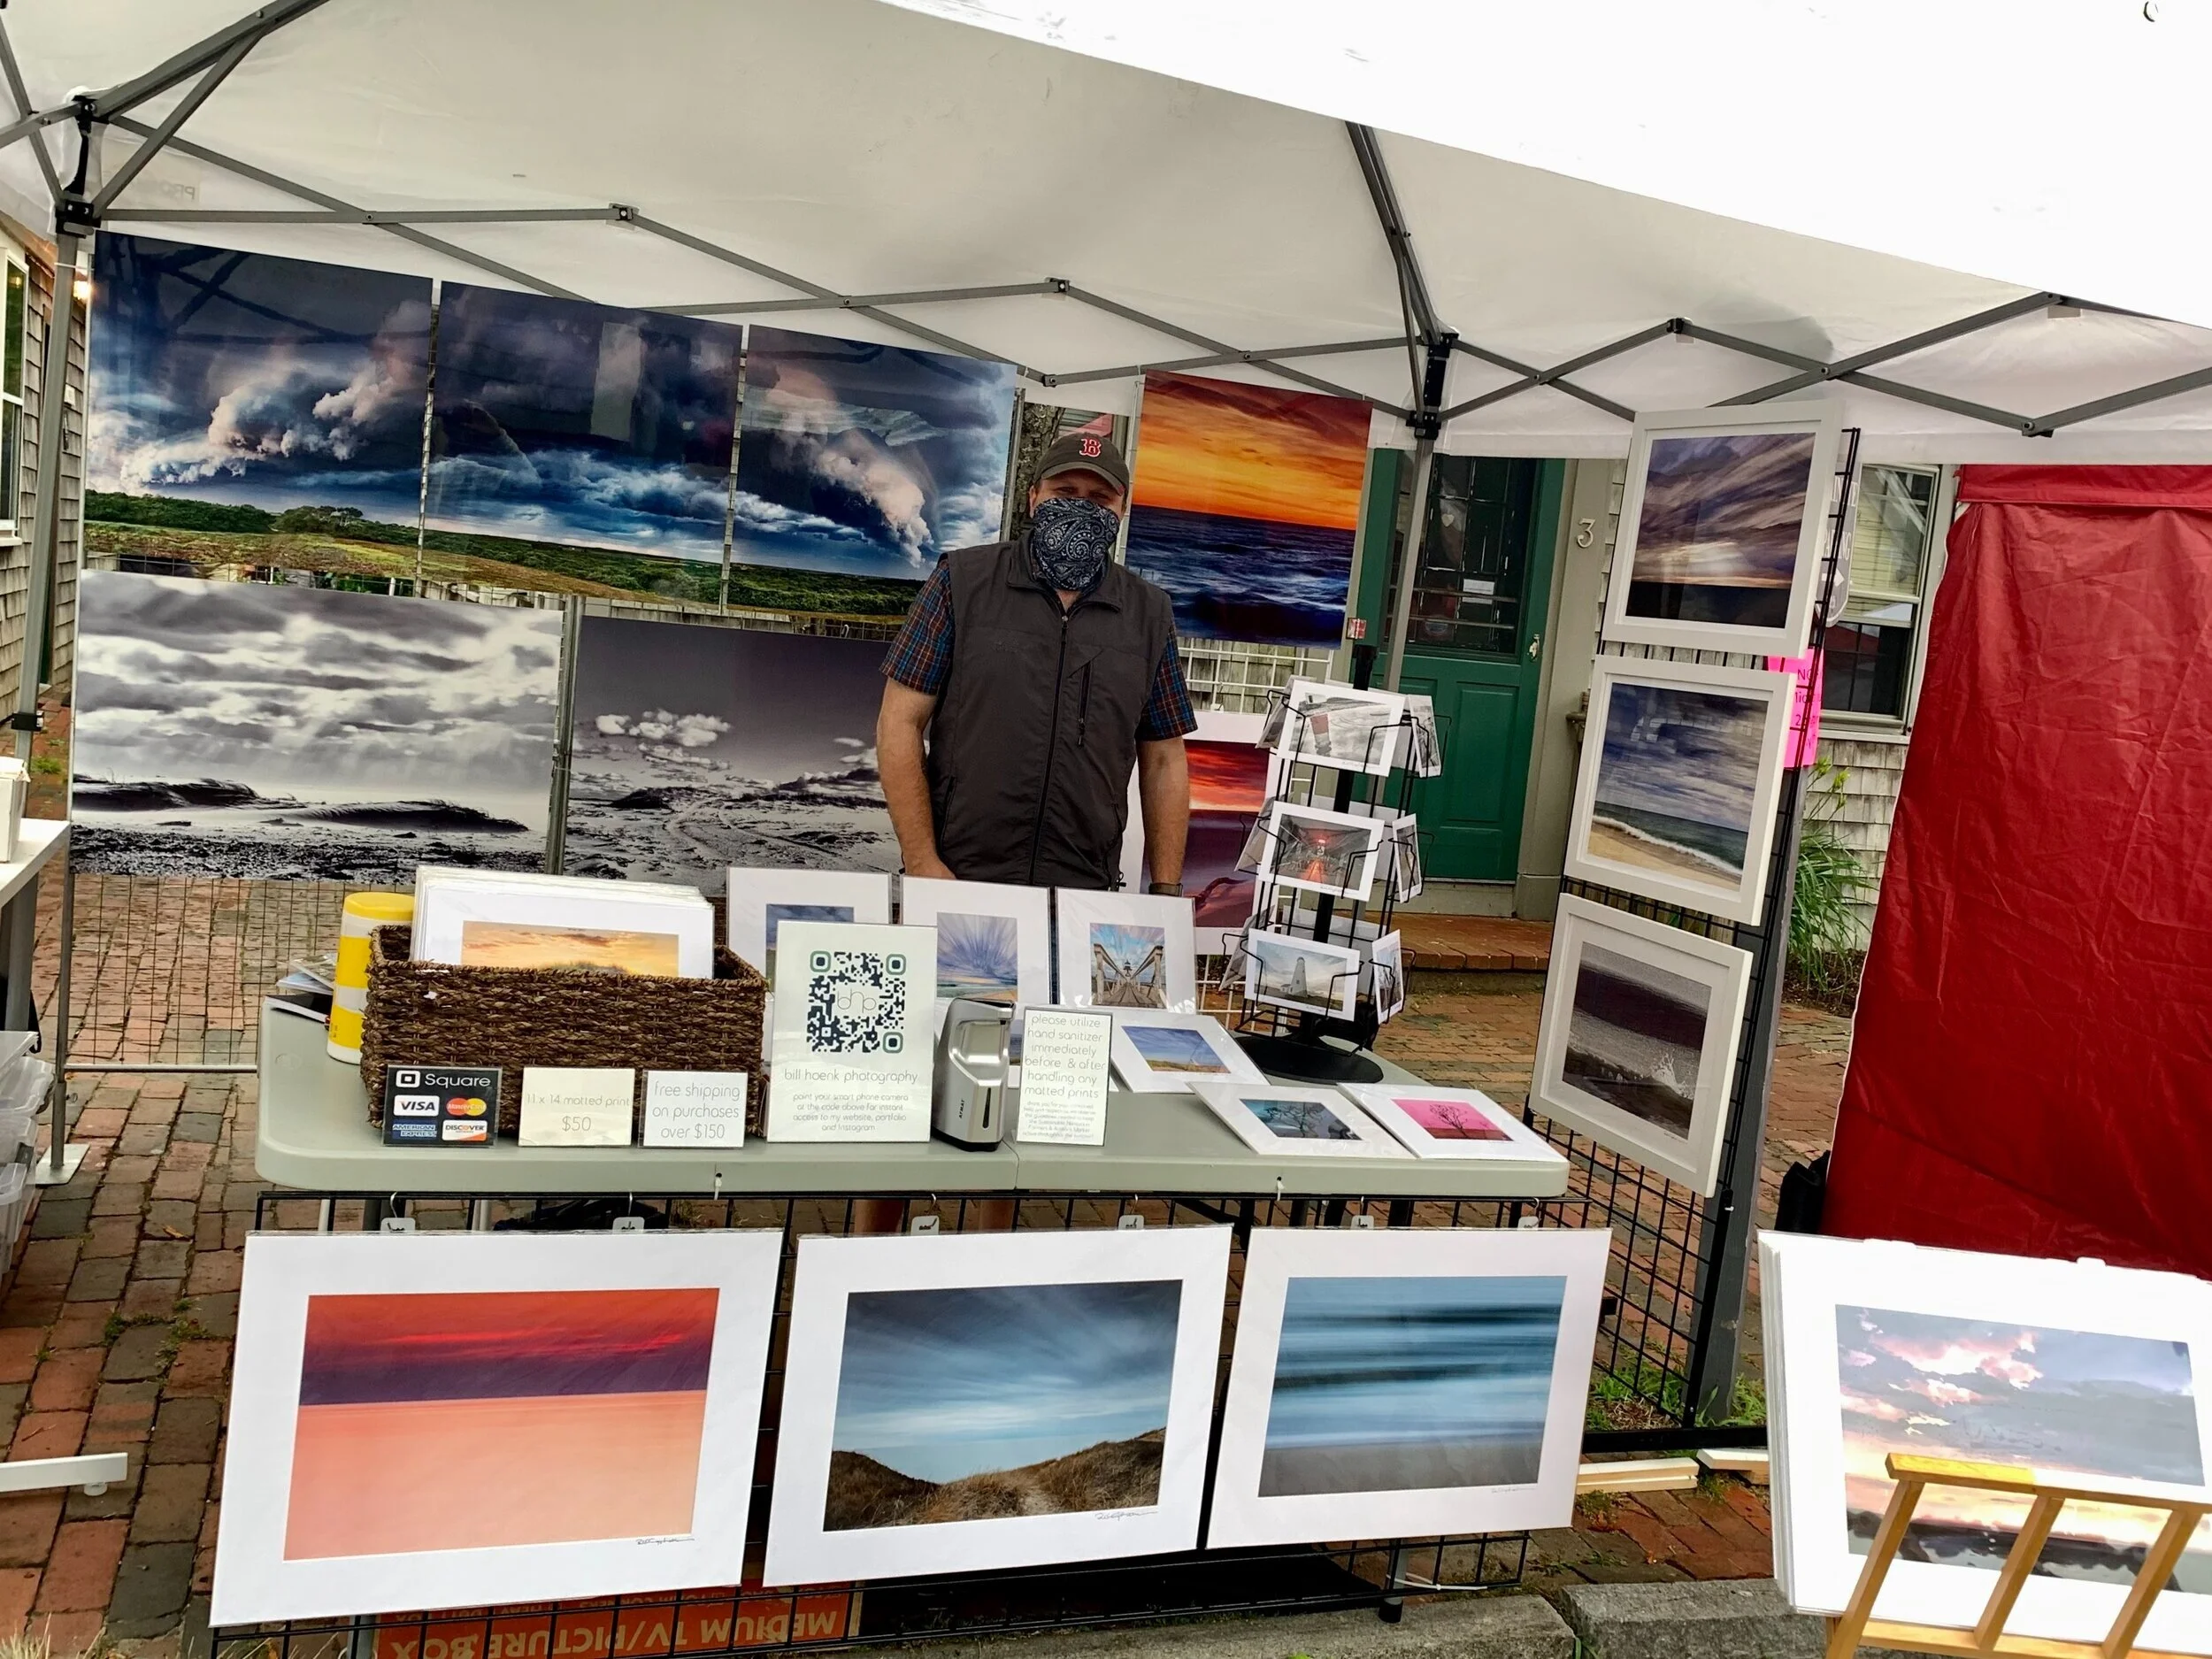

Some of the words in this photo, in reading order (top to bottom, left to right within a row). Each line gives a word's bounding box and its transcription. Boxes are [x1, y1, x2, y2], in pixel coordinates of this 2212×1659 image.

[1079, 437, 1102, 457] B
[1577, 518, 1595, 549] 3
[1031, 1014, 1067, 1026] please
[1070, 1017, 1101, 1028] utilize
[1027, 1027, 1056, 1040] hand
[1058, 1031, 1103, 1043] sanitizer
[1032, 1043, 1096, 1058] immediately
[1067, 1057, 1076, 1069] &
[1079, 1059, 1106, 1071] after
[425, 1073, 491, 1089] Square
[784, 1068, 801, 1081] bill
[804, 1068, 840, 1081] hoenk
[843, 1069, 918, 1085] photography
[1027, 1070, 1075, 1085] handling
[1078, 1075, 1097, 1087] any
[655, 1080, 681, 1097] free
[685, 1082, 740, 1102] shipping
[793, 1093, 812, 1102] point
[856, 1093, 879, 1102] phone
[1024, 1086, 1065, 1097] matted
[1067, 1088, 1099, 1100] prints
[400, 1101, 435, 1111] VISA
[538, 1096, 545, 1105] x
[549, 1094, 560, 1104] 14
[564, 1094, 603, 1106] matted
[605, 1096, 630, 1109] print
[807, 1102, 819, 1111] the
[652, 1106, 669, 1118] on
[672, 1102, 739, 1122] purchases
[875, 1113, 907, 1123] portfolio
[562, 1116, 592, 1132] $50
[661, 1127, 690, 1139] over
[695, 1123, 726, 1139] $150
[839, 1124, 876, 1133] Instagram
[700, 1609, 838, 1644] MEDIUM
[388, 1634, 479, 1659] BOX
[488, 1620, 688, 1658] TV/PICTURE
